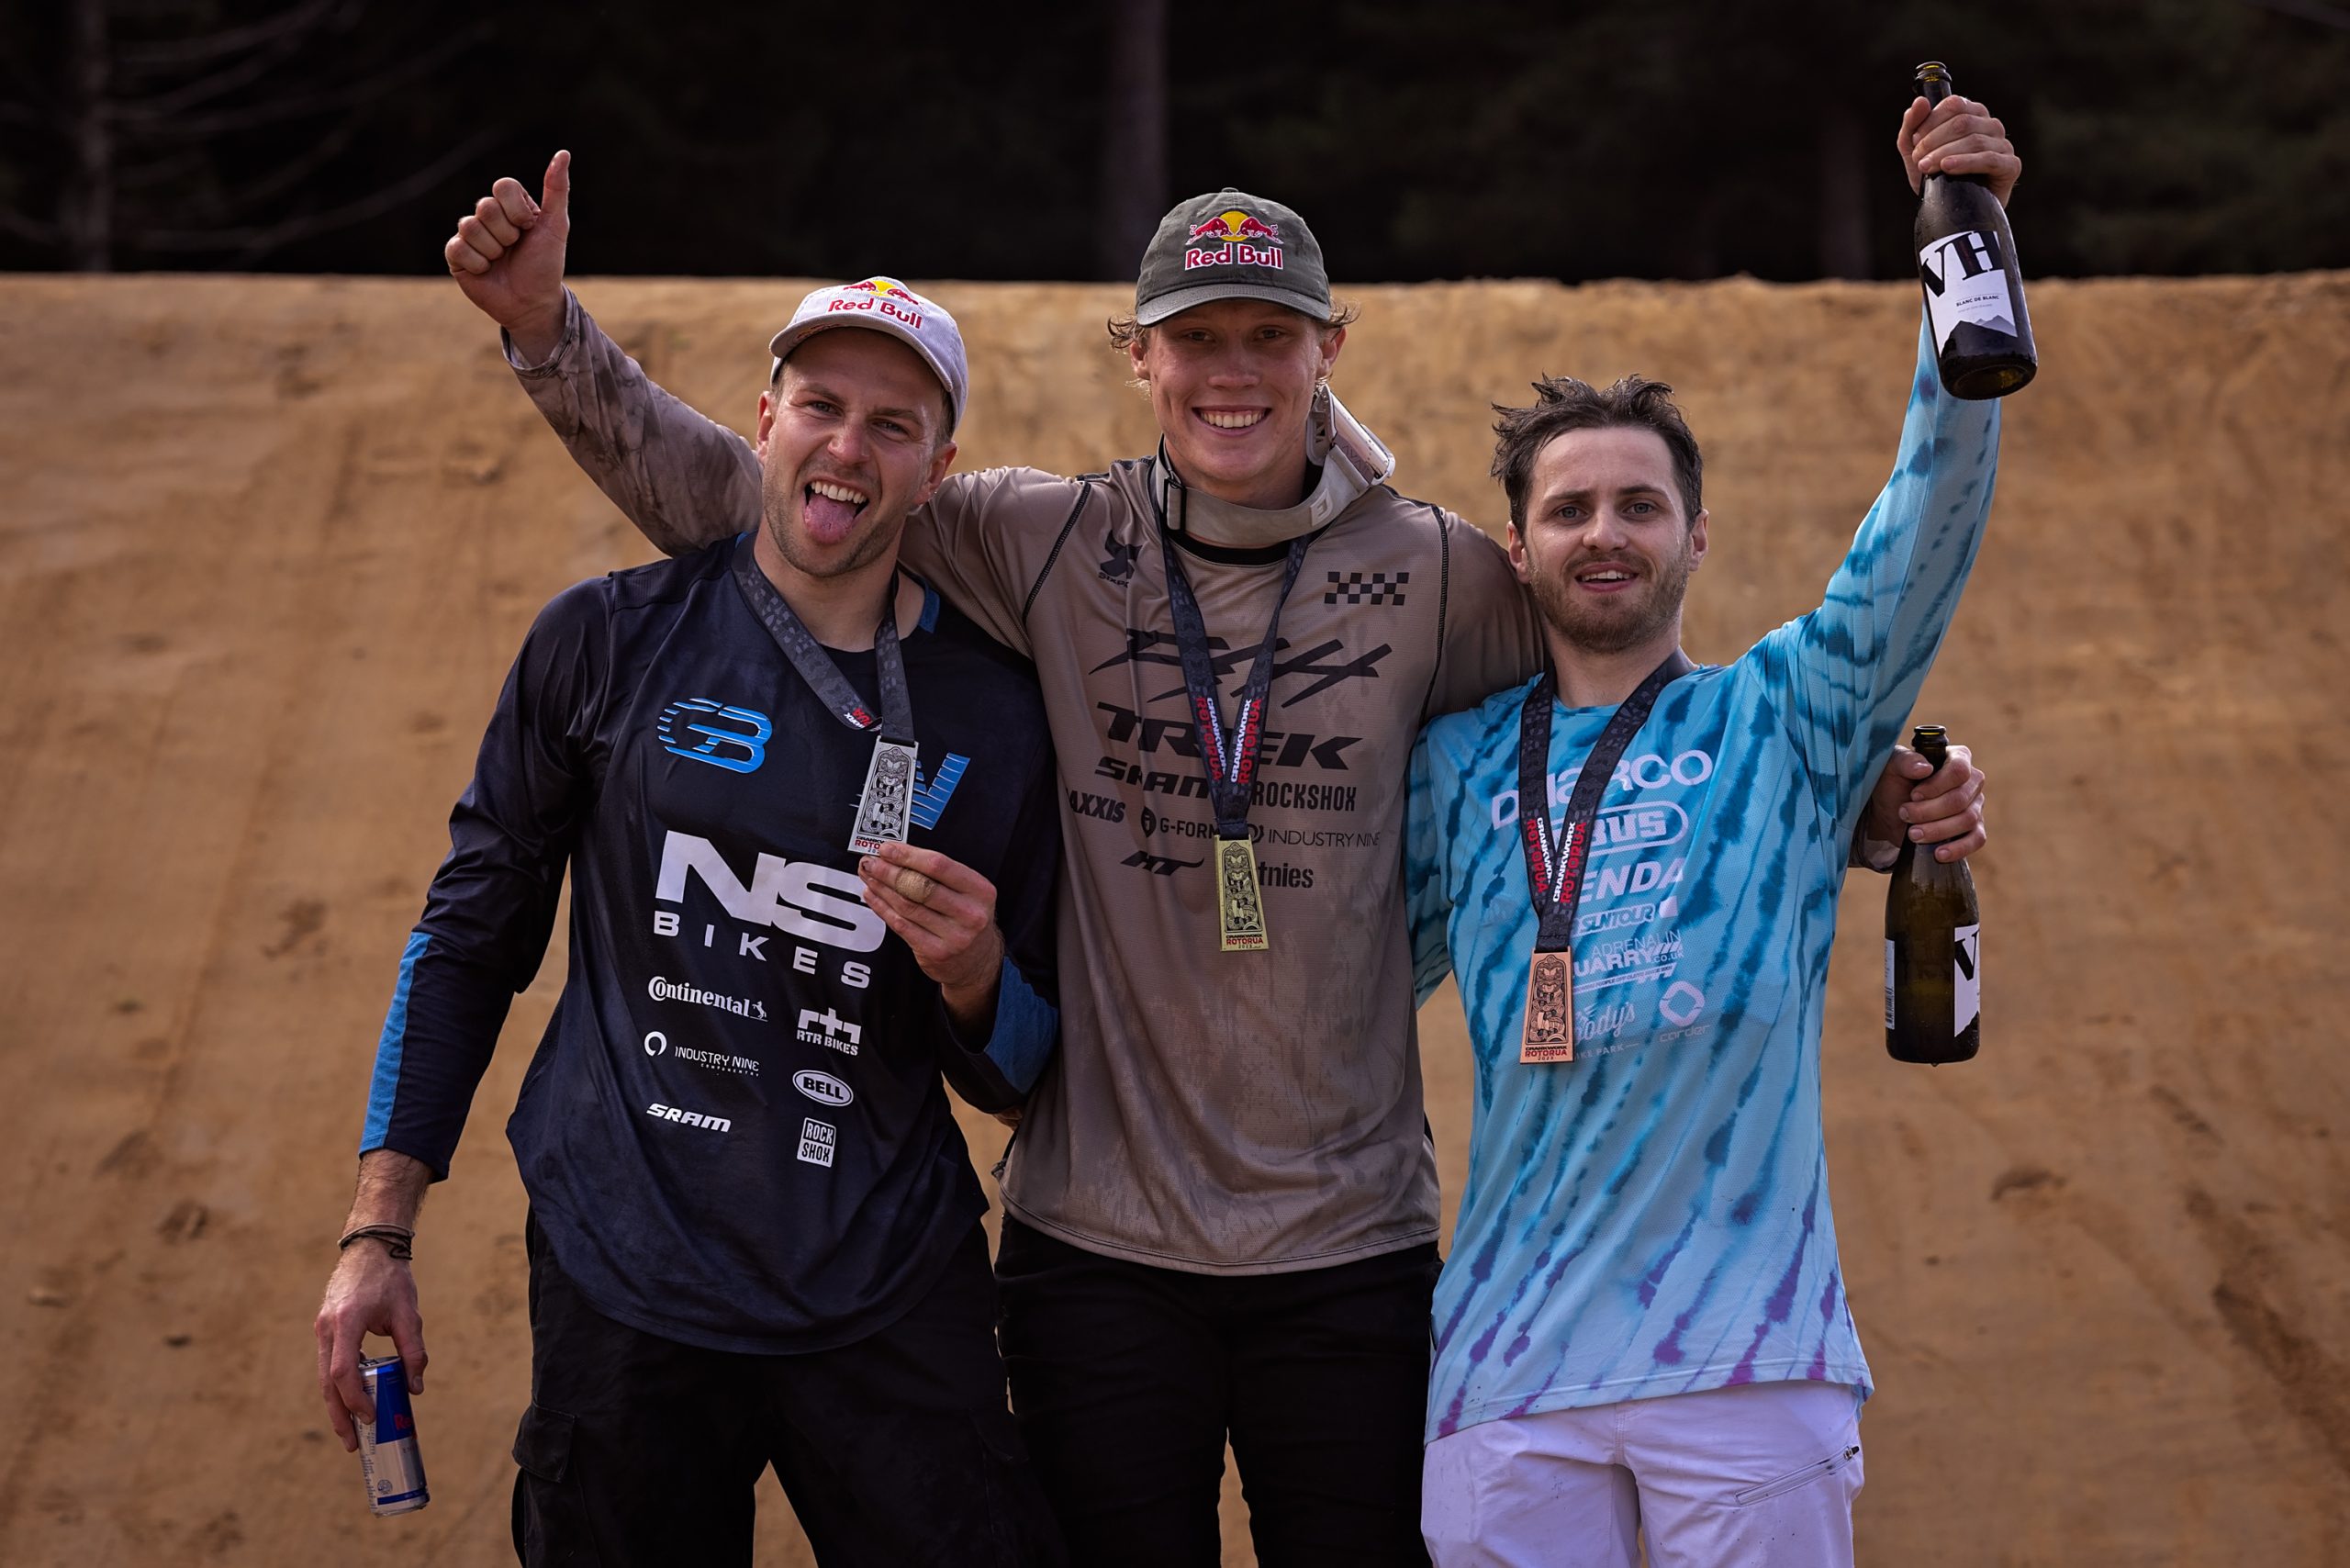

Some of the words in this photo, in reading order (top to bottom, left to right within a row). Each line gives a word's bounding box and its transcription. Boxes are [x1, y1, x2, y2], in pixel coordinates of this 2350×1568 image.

[1184, 243, 1233, 271] Red
[1237, 243, 1283, 271] Bull
[828, 297, 874, 312] Red
[879, 301, 923, 330] Bull
[1956, 298, 1973, 307] BLANC
[1196, 697, 1223, 781] ROTORUA
[1207, 698, 1227, 775] CRANKWOR
[1231, 699, 1252, 783] CRANKWORX
[1238, 699, 1262, 784] ROTORUA
[1066, 790, 1126, 823] AXXIS
[1250, 781, 1357, 812] ROCKSHOX
[1269, 829, 1355, 847] INDUSTRY
[1593, 811, 1667, 846] BUS
[1527, 820, 1549, 892] ROTORUA
[1537, 817, 1552, 885] CRANKWOR
[1552, 822, 1575, 902] CRANKWORX
[1561, 823, 1587, 903] ROTORUA
[1258, 860, 1314, 889] tnies
[1579, 858, 1684, 904] ENDA
[655, 830, 887, 953] NS
[1578, 906, 1655, 935] SUNTOUR
[654, 911, 871, 989] BIKES
[1225, 937, 1263, 946] ROTORUA
[1592, 929, 1681, 958] ADRENALIN
[1574, 946, 1655, 978] UARRY
[648, 976, 749, 1018] Continental
[796, 1029, 822, 1045] RTR
[823, 1035, 858, 1056] BIKES
[675, 1046, 730, 1067] INDUSTRY
[732, 1056, 760, 1072] NINE
[802, 1077, 845, 1100] BELL
[646, 1103, 732, 1132] SRAM
[805, 1120, 834, 1145] ROCK
[801, 1141, 830, 1164] SHOX
